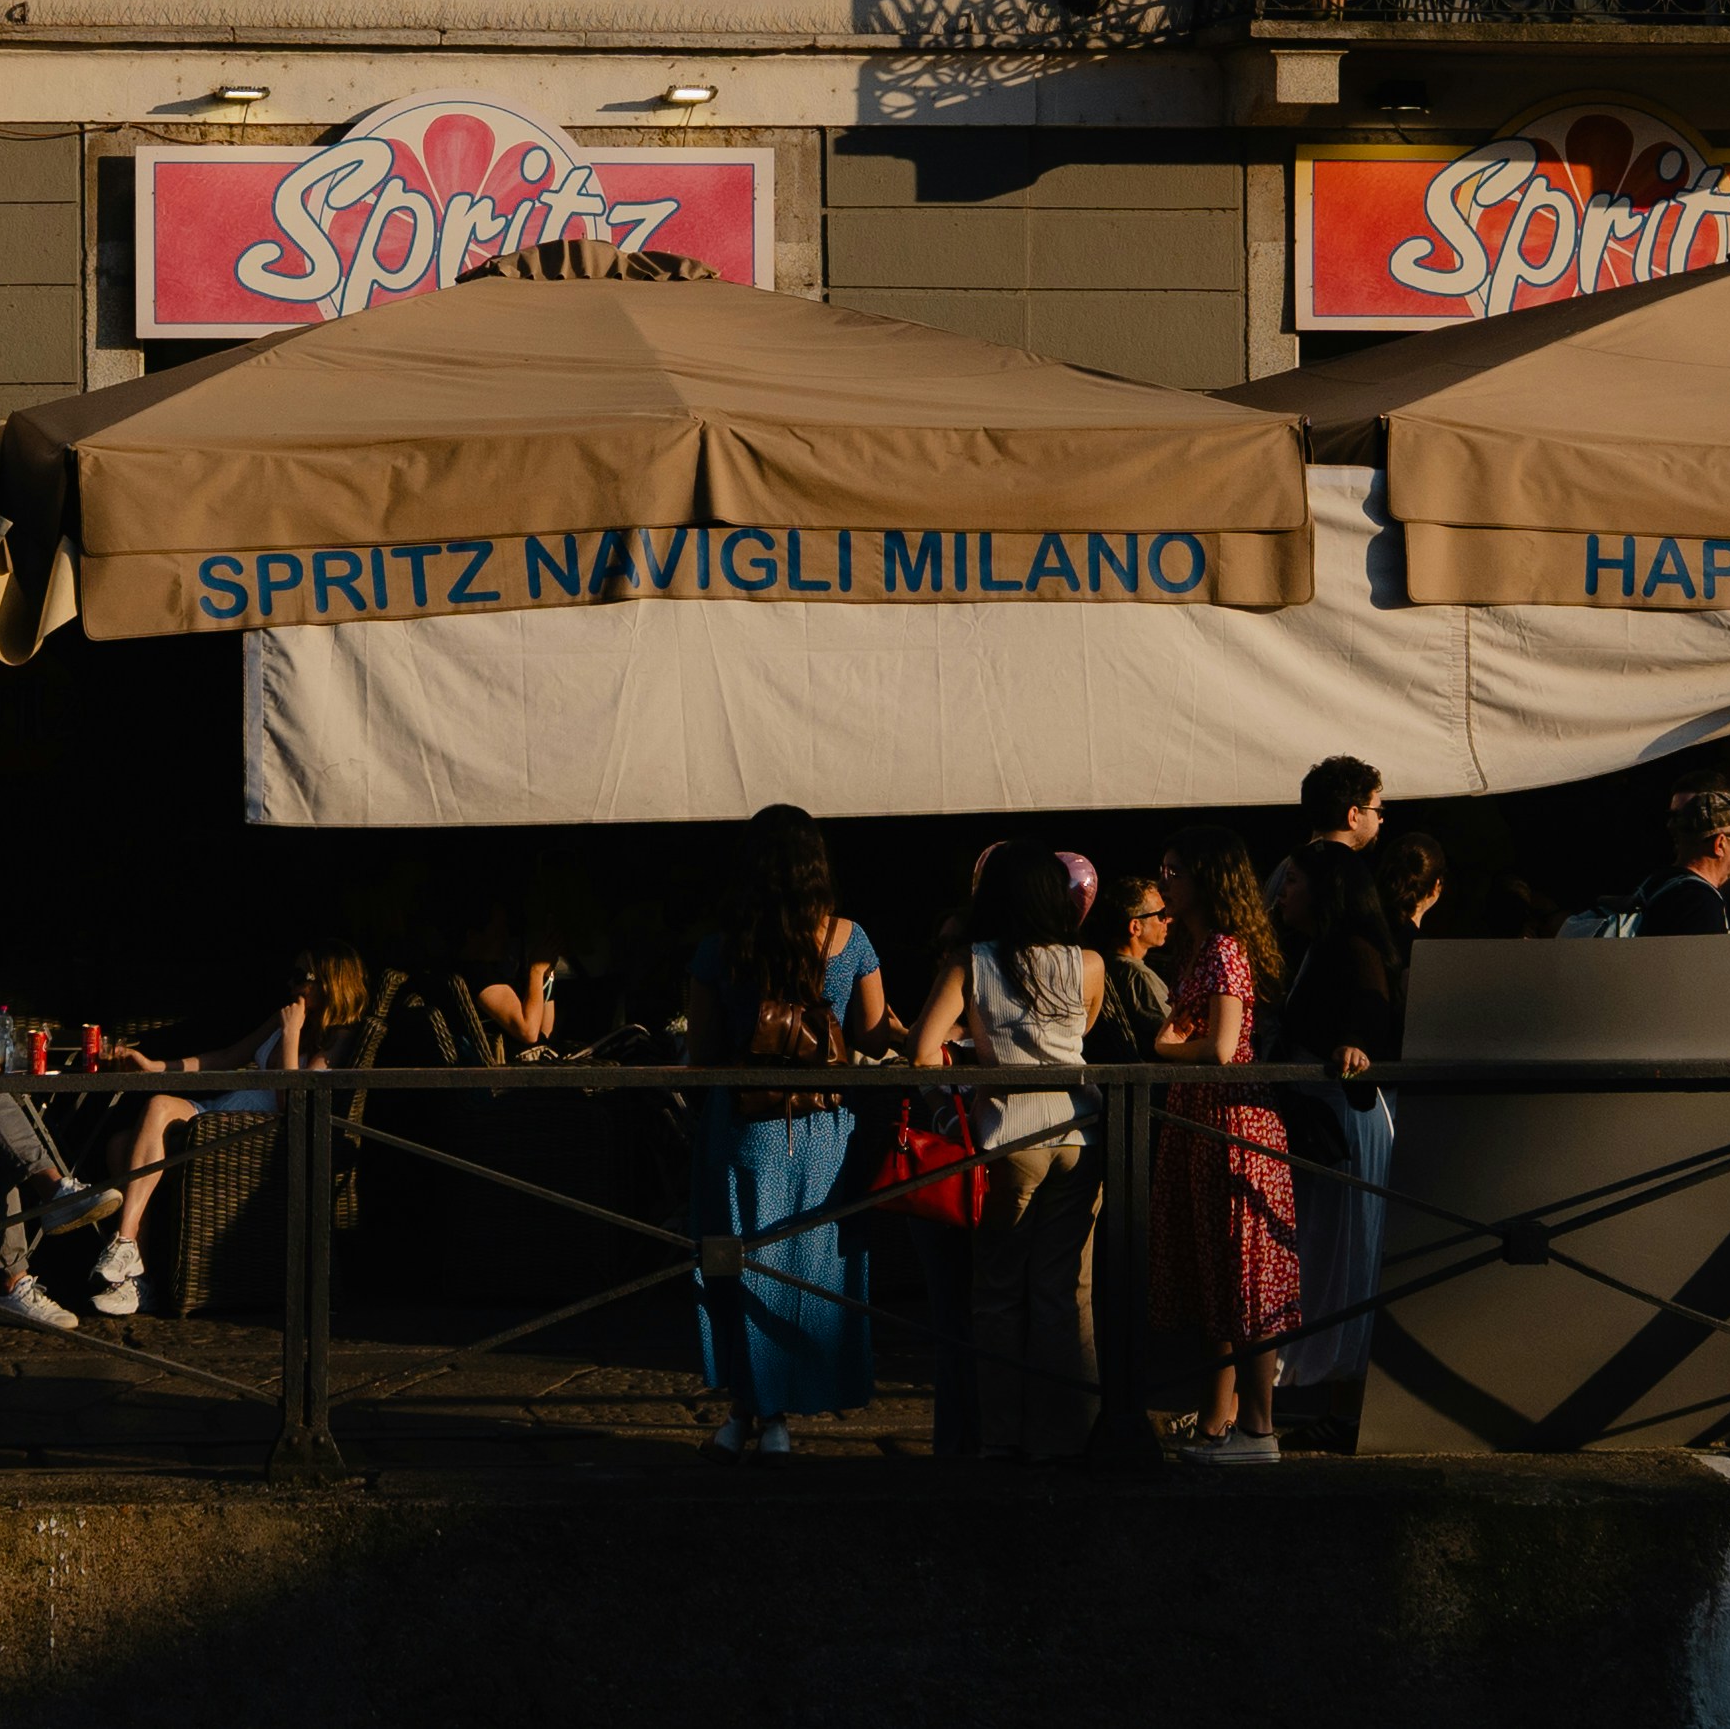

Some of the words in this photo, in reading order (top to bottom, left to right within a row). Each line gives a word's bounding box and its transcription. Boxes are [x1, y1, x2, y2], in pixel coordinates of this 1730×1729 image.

[198, 539, 501, 620] SPRITZ
[524, 527, 853, 601] NAVIGLI
[883, 529, 1207, 594] MILANO
